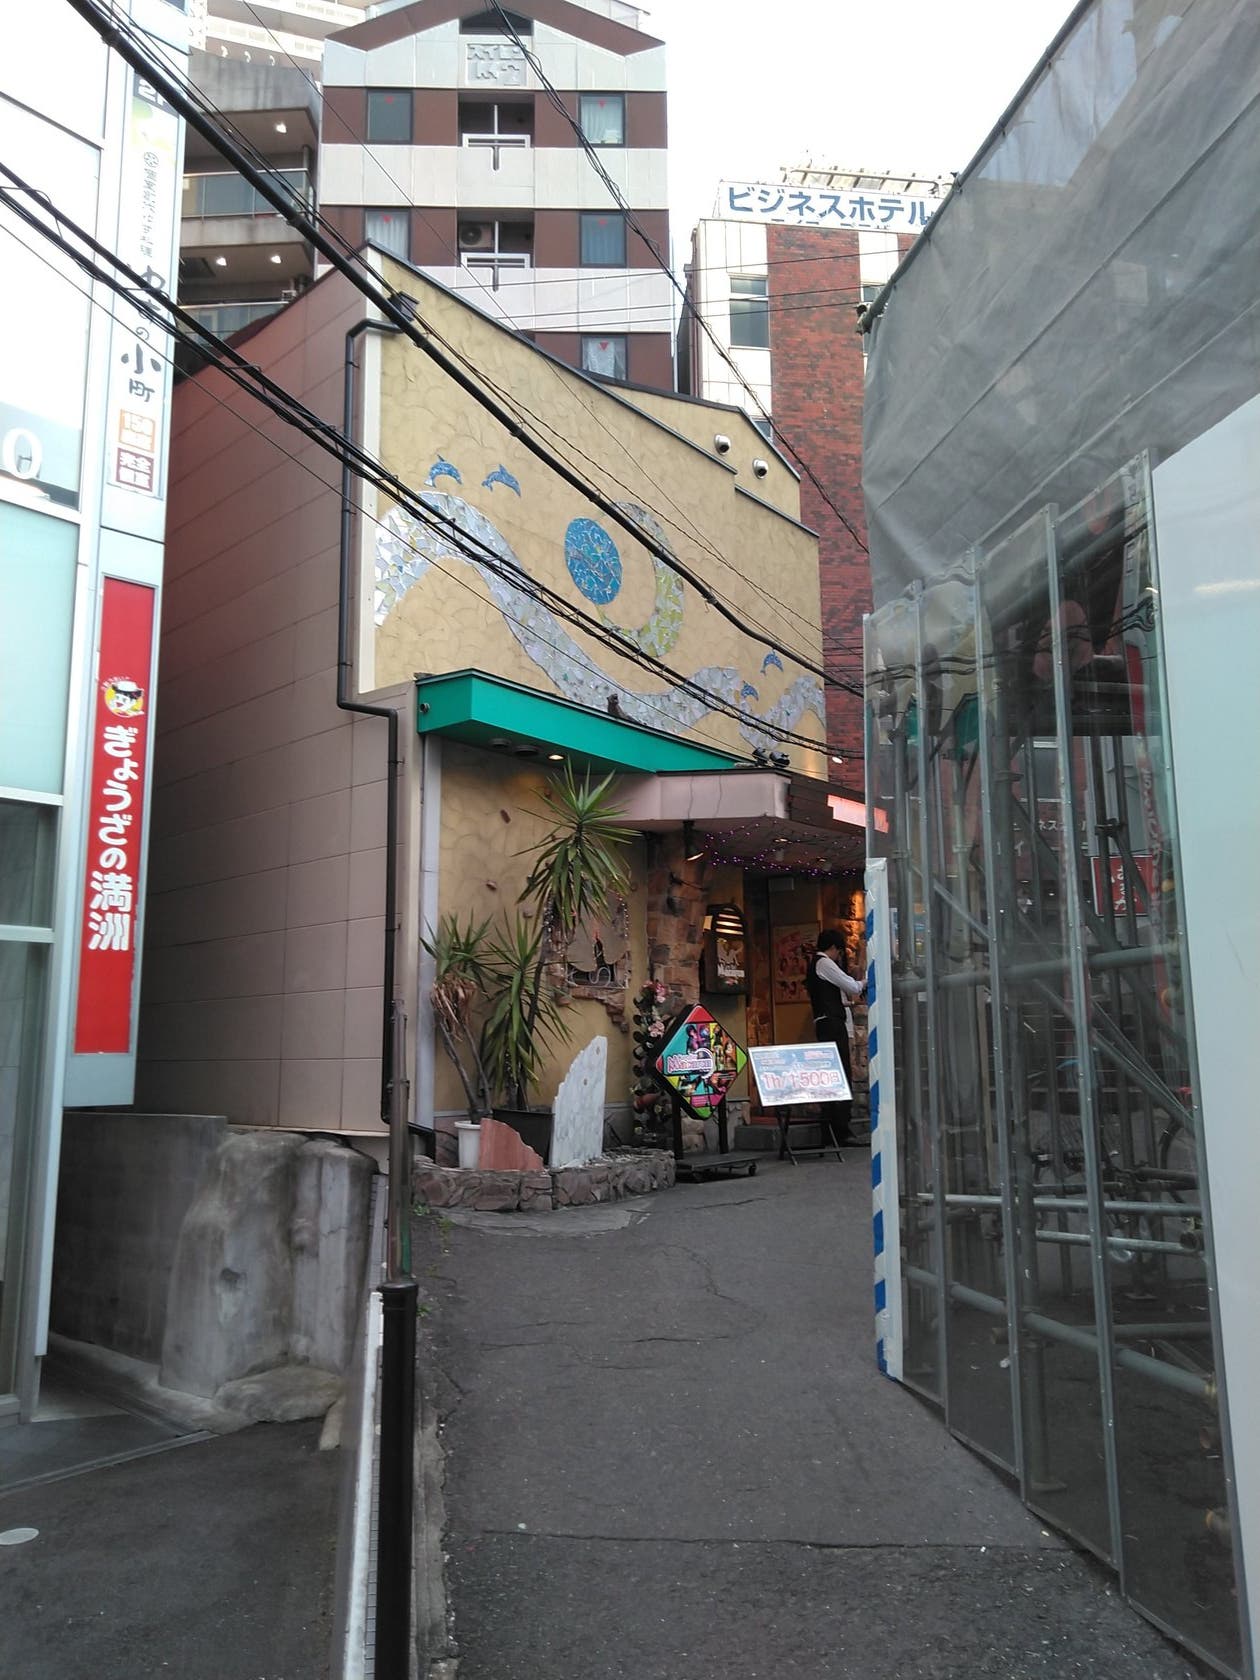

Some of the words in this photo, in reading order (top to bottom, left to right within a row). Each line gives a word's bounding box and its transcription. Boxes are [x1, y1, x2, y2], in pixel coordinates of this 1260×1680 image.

[729, 186, 929, 226] ビジネスホテル
[88, 725, 138, 951] ぎょうざの満洲
